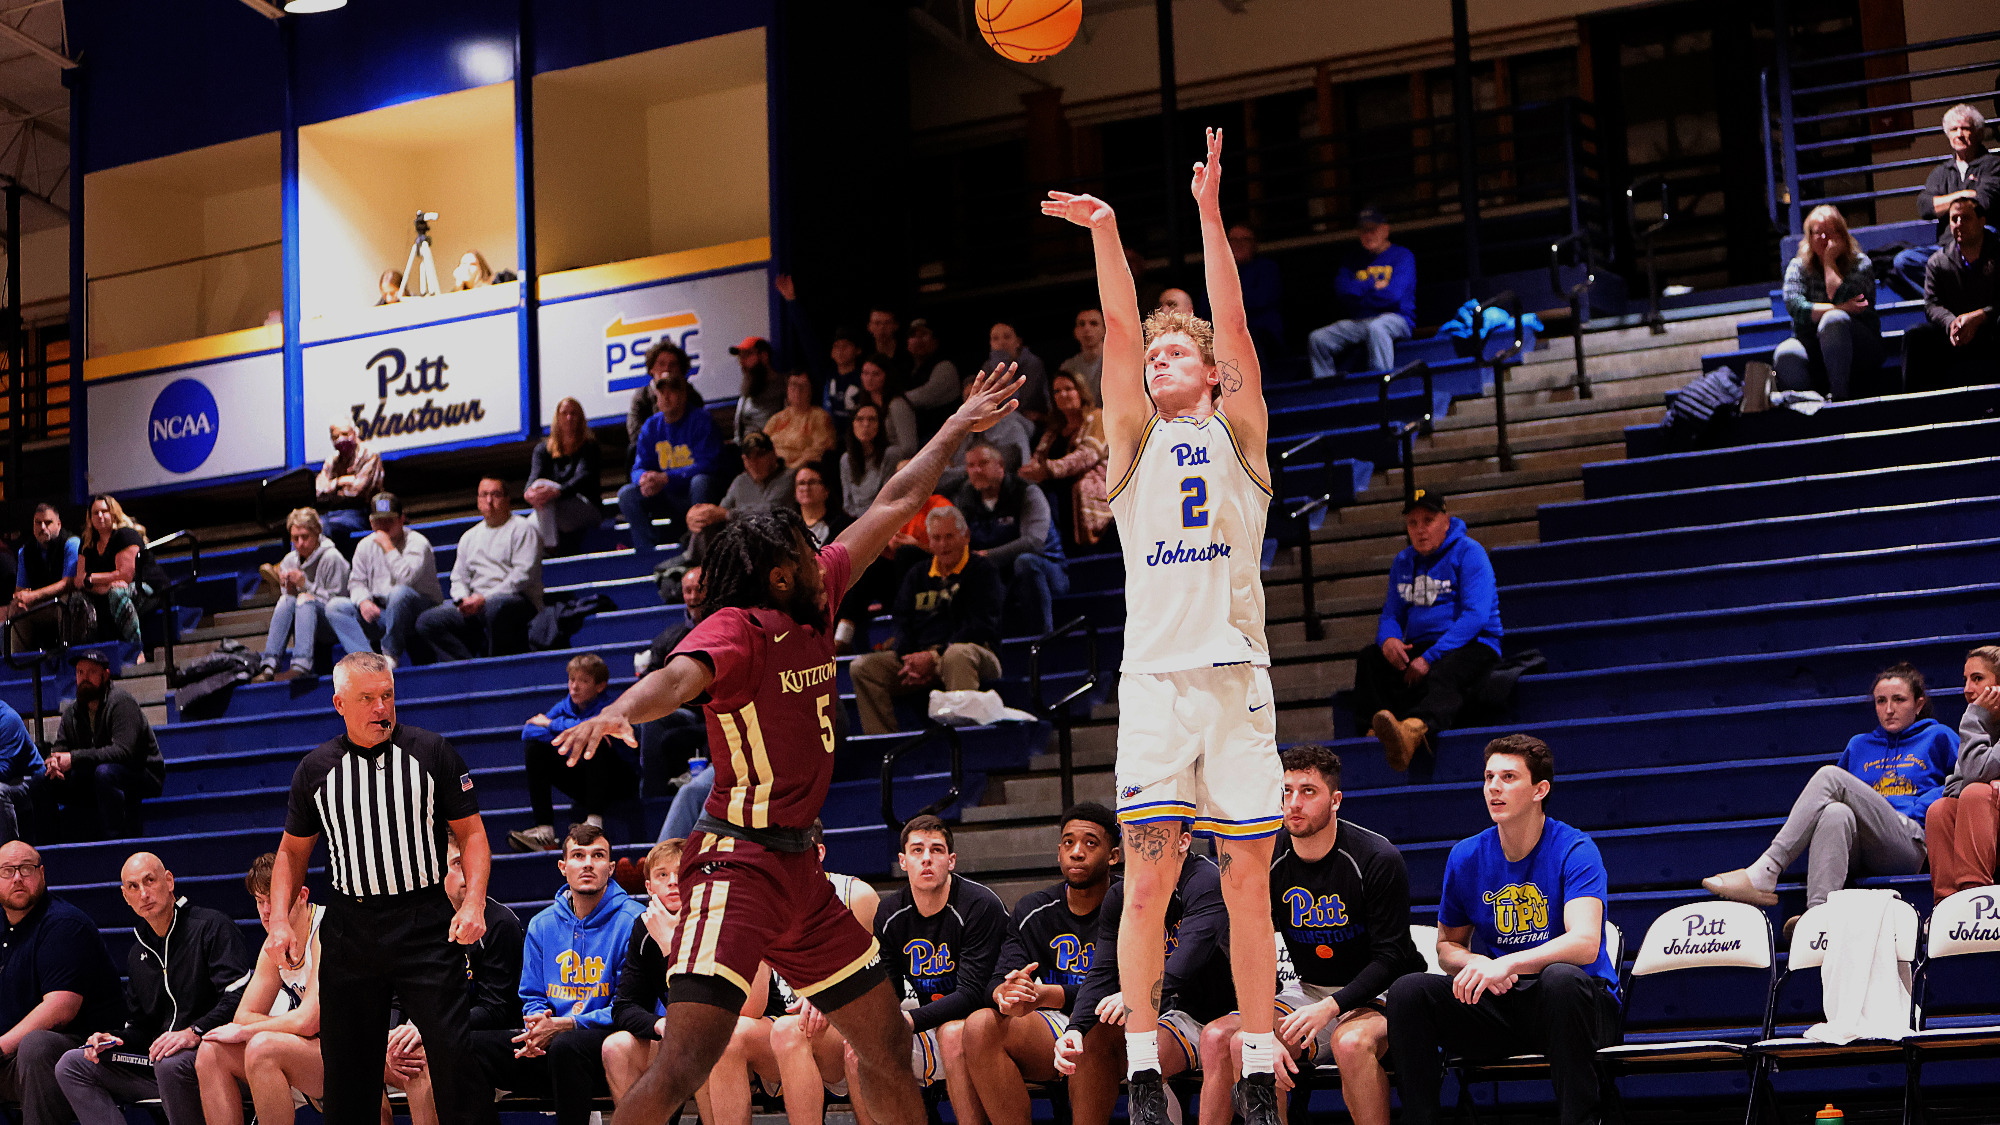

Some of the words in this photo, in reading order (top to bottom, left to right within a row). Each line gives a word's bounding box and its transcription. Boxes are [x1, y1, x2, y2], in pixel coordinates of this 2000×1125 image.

[606, 329, 701, 374] PSC
[365, 347, 450, 399] Pitt
[152, 411, 211, 443] NCAA
[1170, 442, 1211, 467] Pitt
[1179, 474, 1210, 530] 2
[1146, 539, 1232, 567] Johnstow
[777, 655, 837, 694] KUTZTOW
[815, 693, 836, 754] 5
[1282, 886, 1349, 928] Pitt
[1968, 894, 2000, 920] Pi
[1682, 914, 1727, 937] Pitt
[1948, 921, 2000, 941] Johns
[1049, 933, 1096, 974] Pit
[1663, 938, 1742, 956] Johnstown
[555, 948, 606, 985] Pitt
[546, 982, 610, 1001] JOHNSTWN
